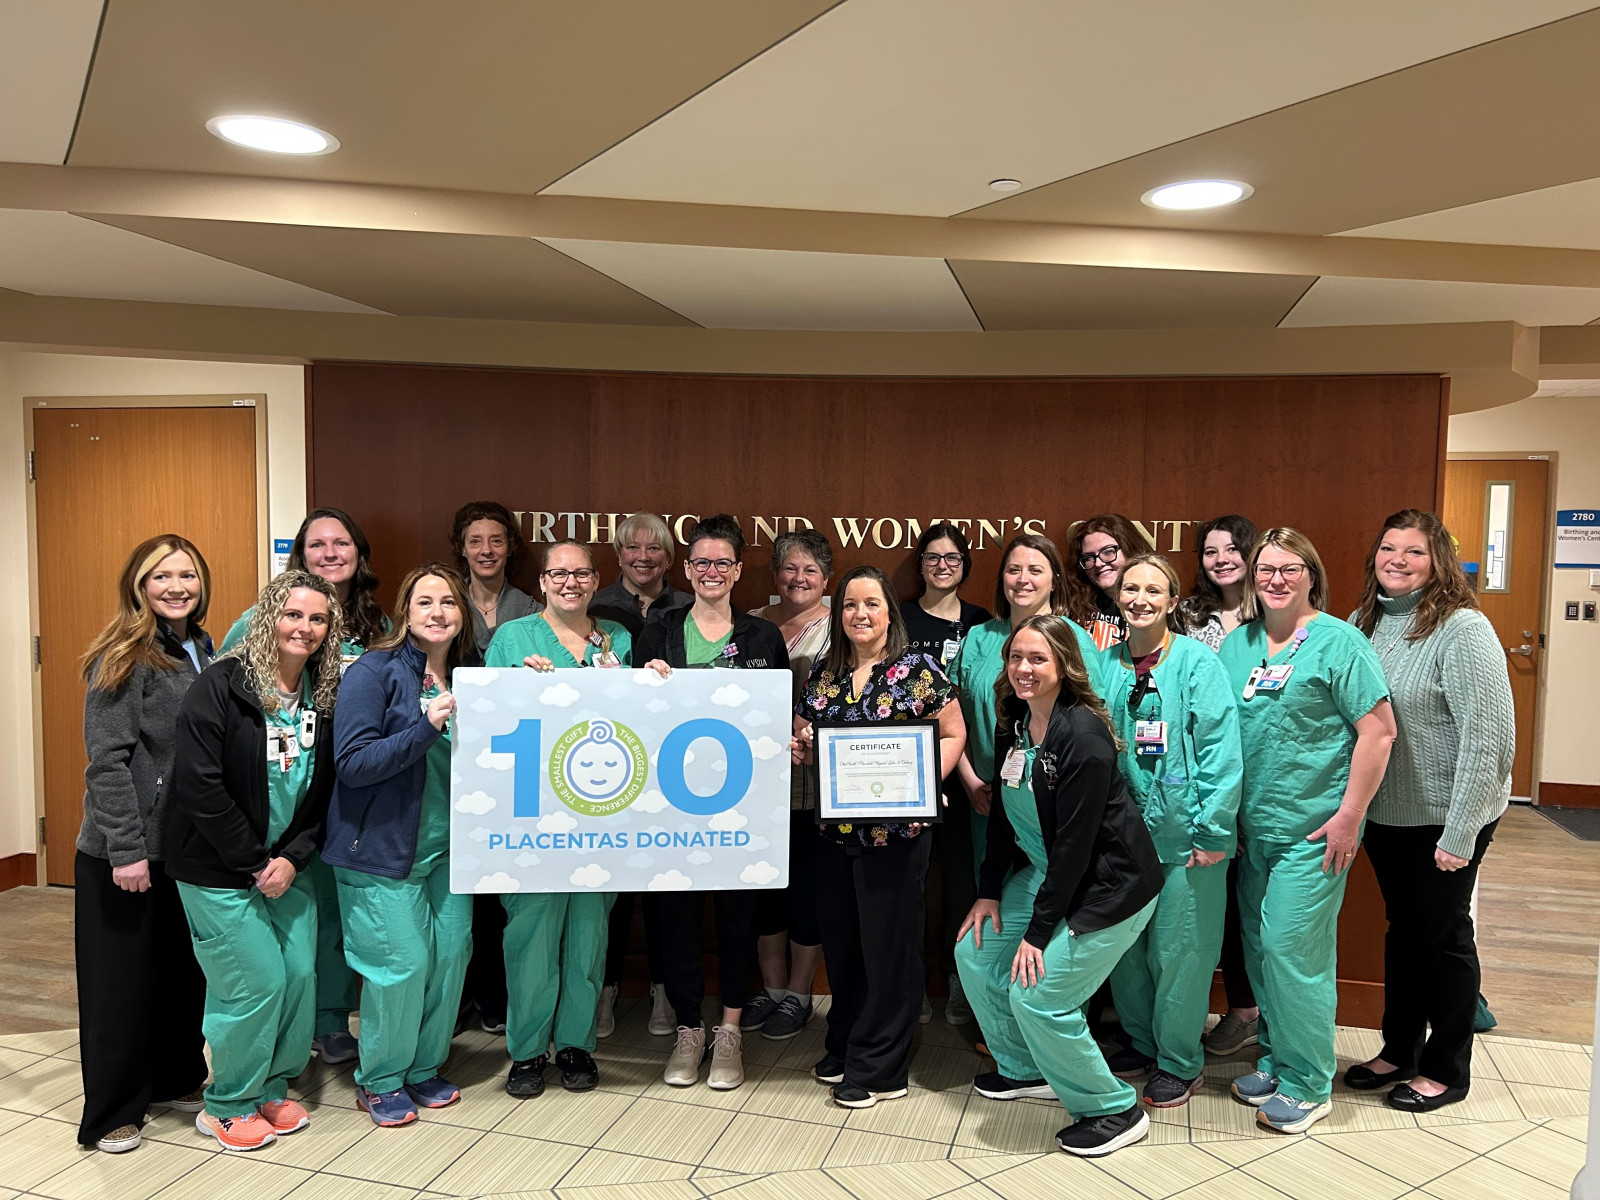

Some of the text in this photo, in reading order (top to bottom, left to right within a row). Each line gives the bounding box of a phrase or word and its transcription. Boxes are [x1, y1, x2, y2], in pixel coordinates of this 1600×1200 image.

[1572, 513, 1595, 521] 2780
[831, 516, 1047, 550] WOMEN'S
[849, 743, 901, 751] CERTIFICATE
[553, 727, 584, 805] THE SMALLEST GIFT
[590, 729, 645, 813] THE BIGGEST DIFFERENCE
[489, 831, 750, 850] PLACENTAS DONATED
